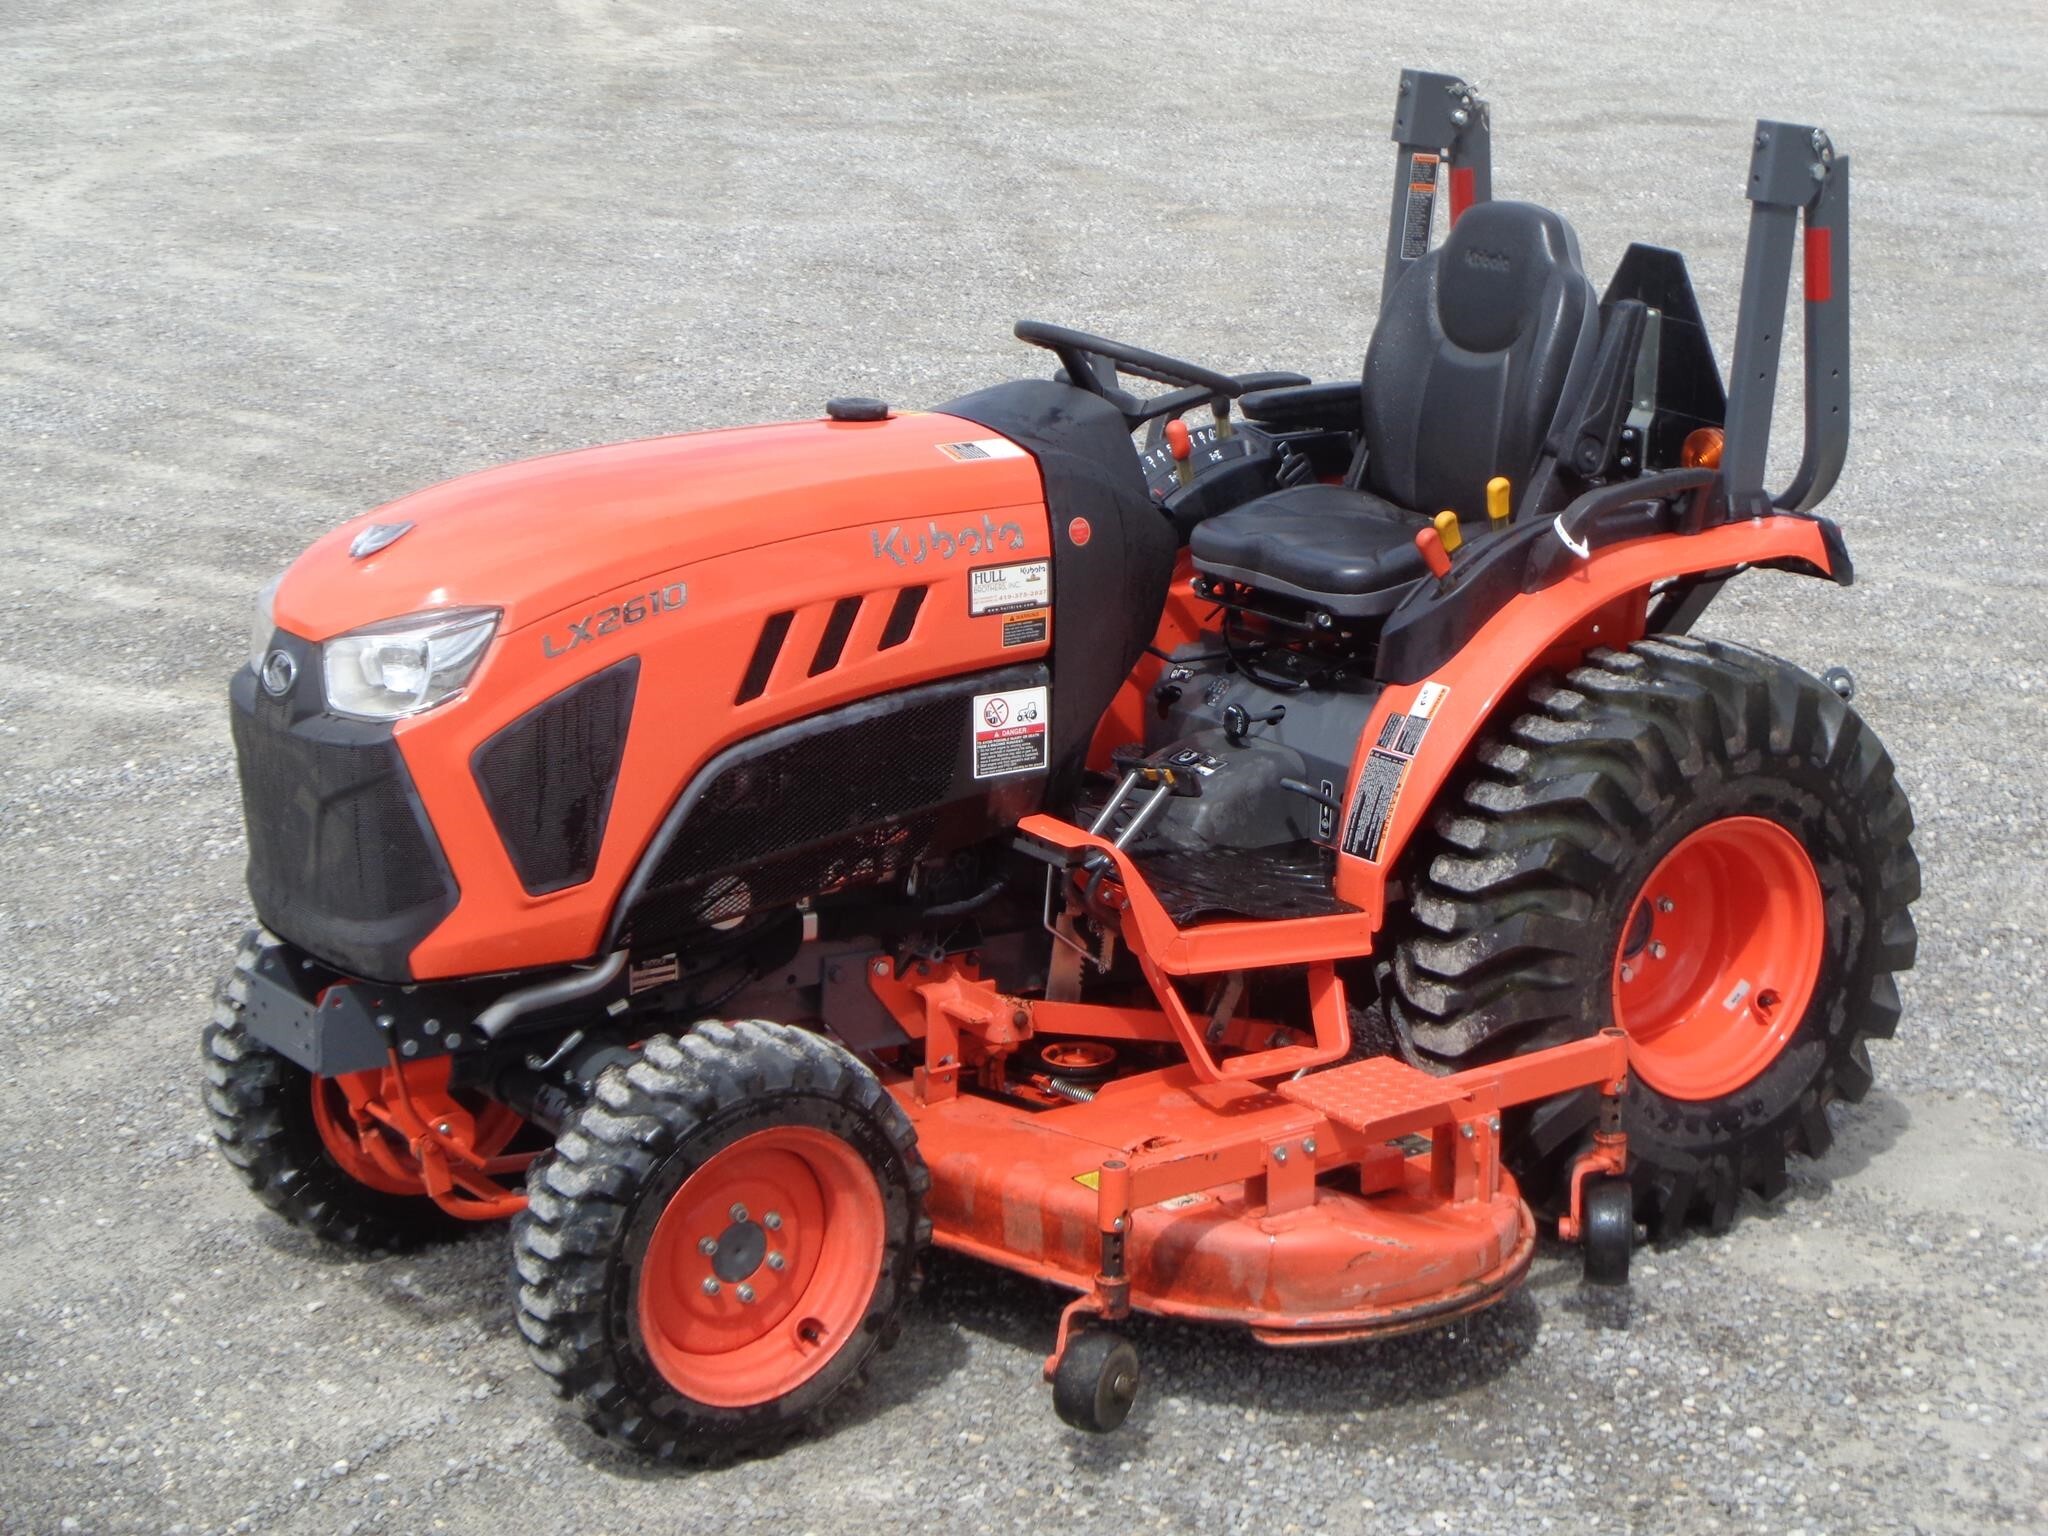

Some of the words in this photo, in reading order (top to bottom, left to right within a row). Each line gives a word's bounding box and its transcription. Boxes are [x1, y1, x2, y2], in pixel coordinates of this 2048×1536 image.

[870, 514, 1024, 566] Kubota
[1020, 565, 1045, 574] Kubota
[974, 570, 1006, 584] HULL
[542, 581, 688, 659] LX2610
[1002, 727, 1027, 736] DANGER
